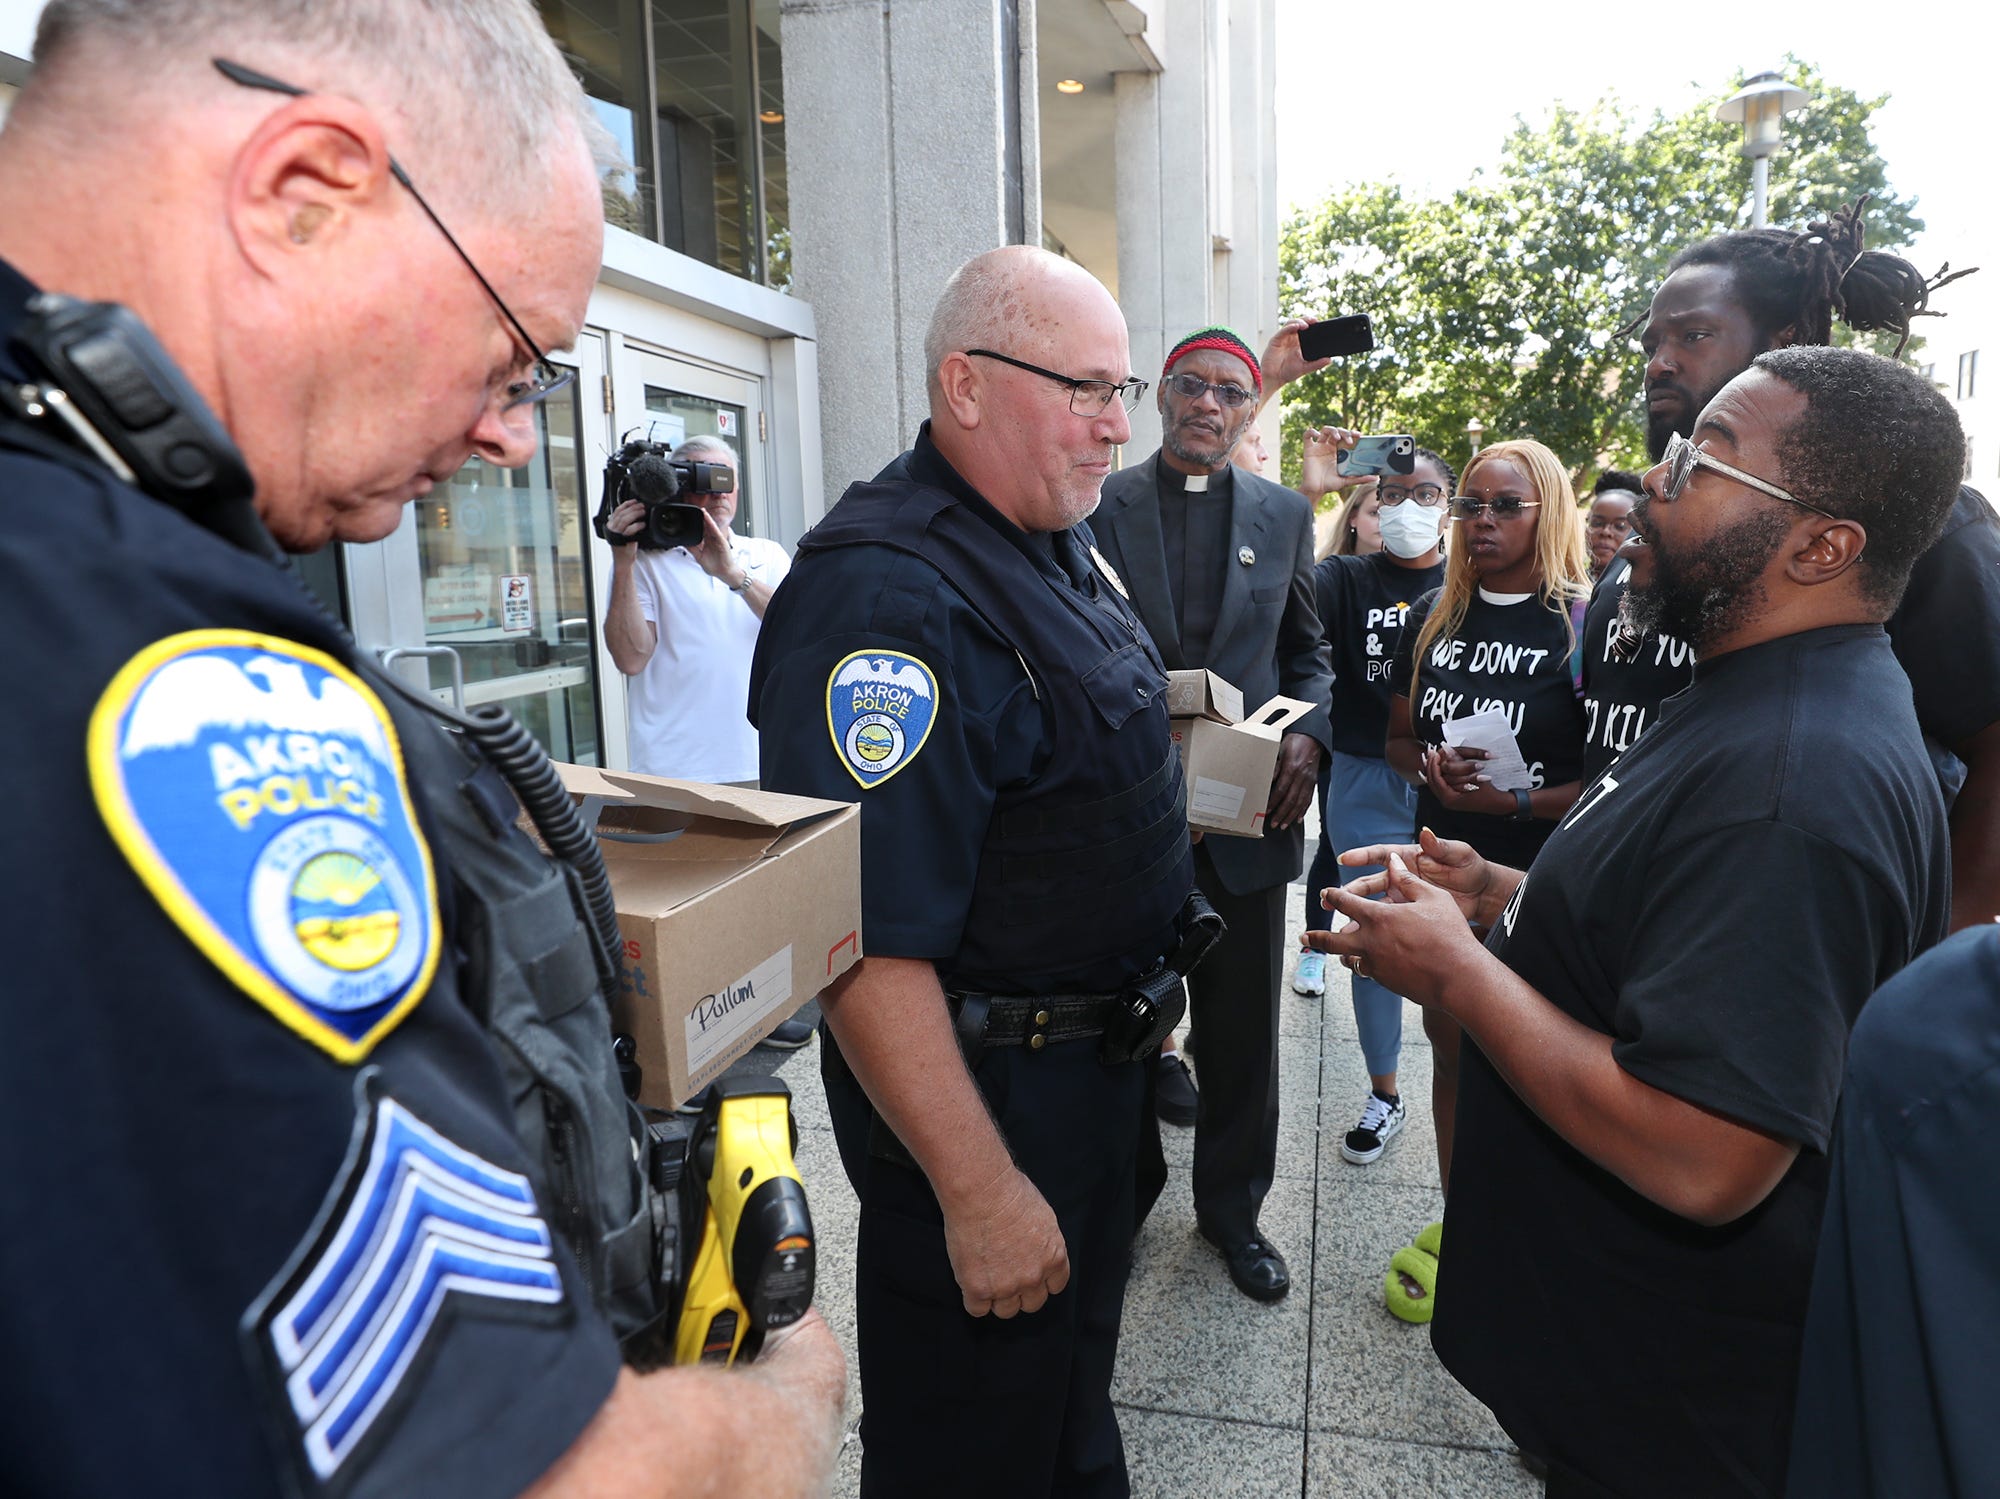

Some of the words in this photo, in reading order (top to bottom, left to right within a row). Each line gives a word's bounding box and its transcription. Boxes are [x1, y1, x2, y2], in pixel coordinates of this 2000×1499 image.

[1366, 633, 1383, 656] &
[1431, 639, 1467, 671] WE
[1468, 641, 1549, 676] DON'T
[852, 684, 914, 707] AKRON
[1420, 687, 1464, 723] PAY
[852, 697, 910, 720] POLICE
[856, 715, 882, 729] STATE
[889, 722, 900, 733] OF
[208, 733, 376, 791] AKRON
[860, 760, 883, 771] OHIO
[217, 774, 387, 831] POLICE
